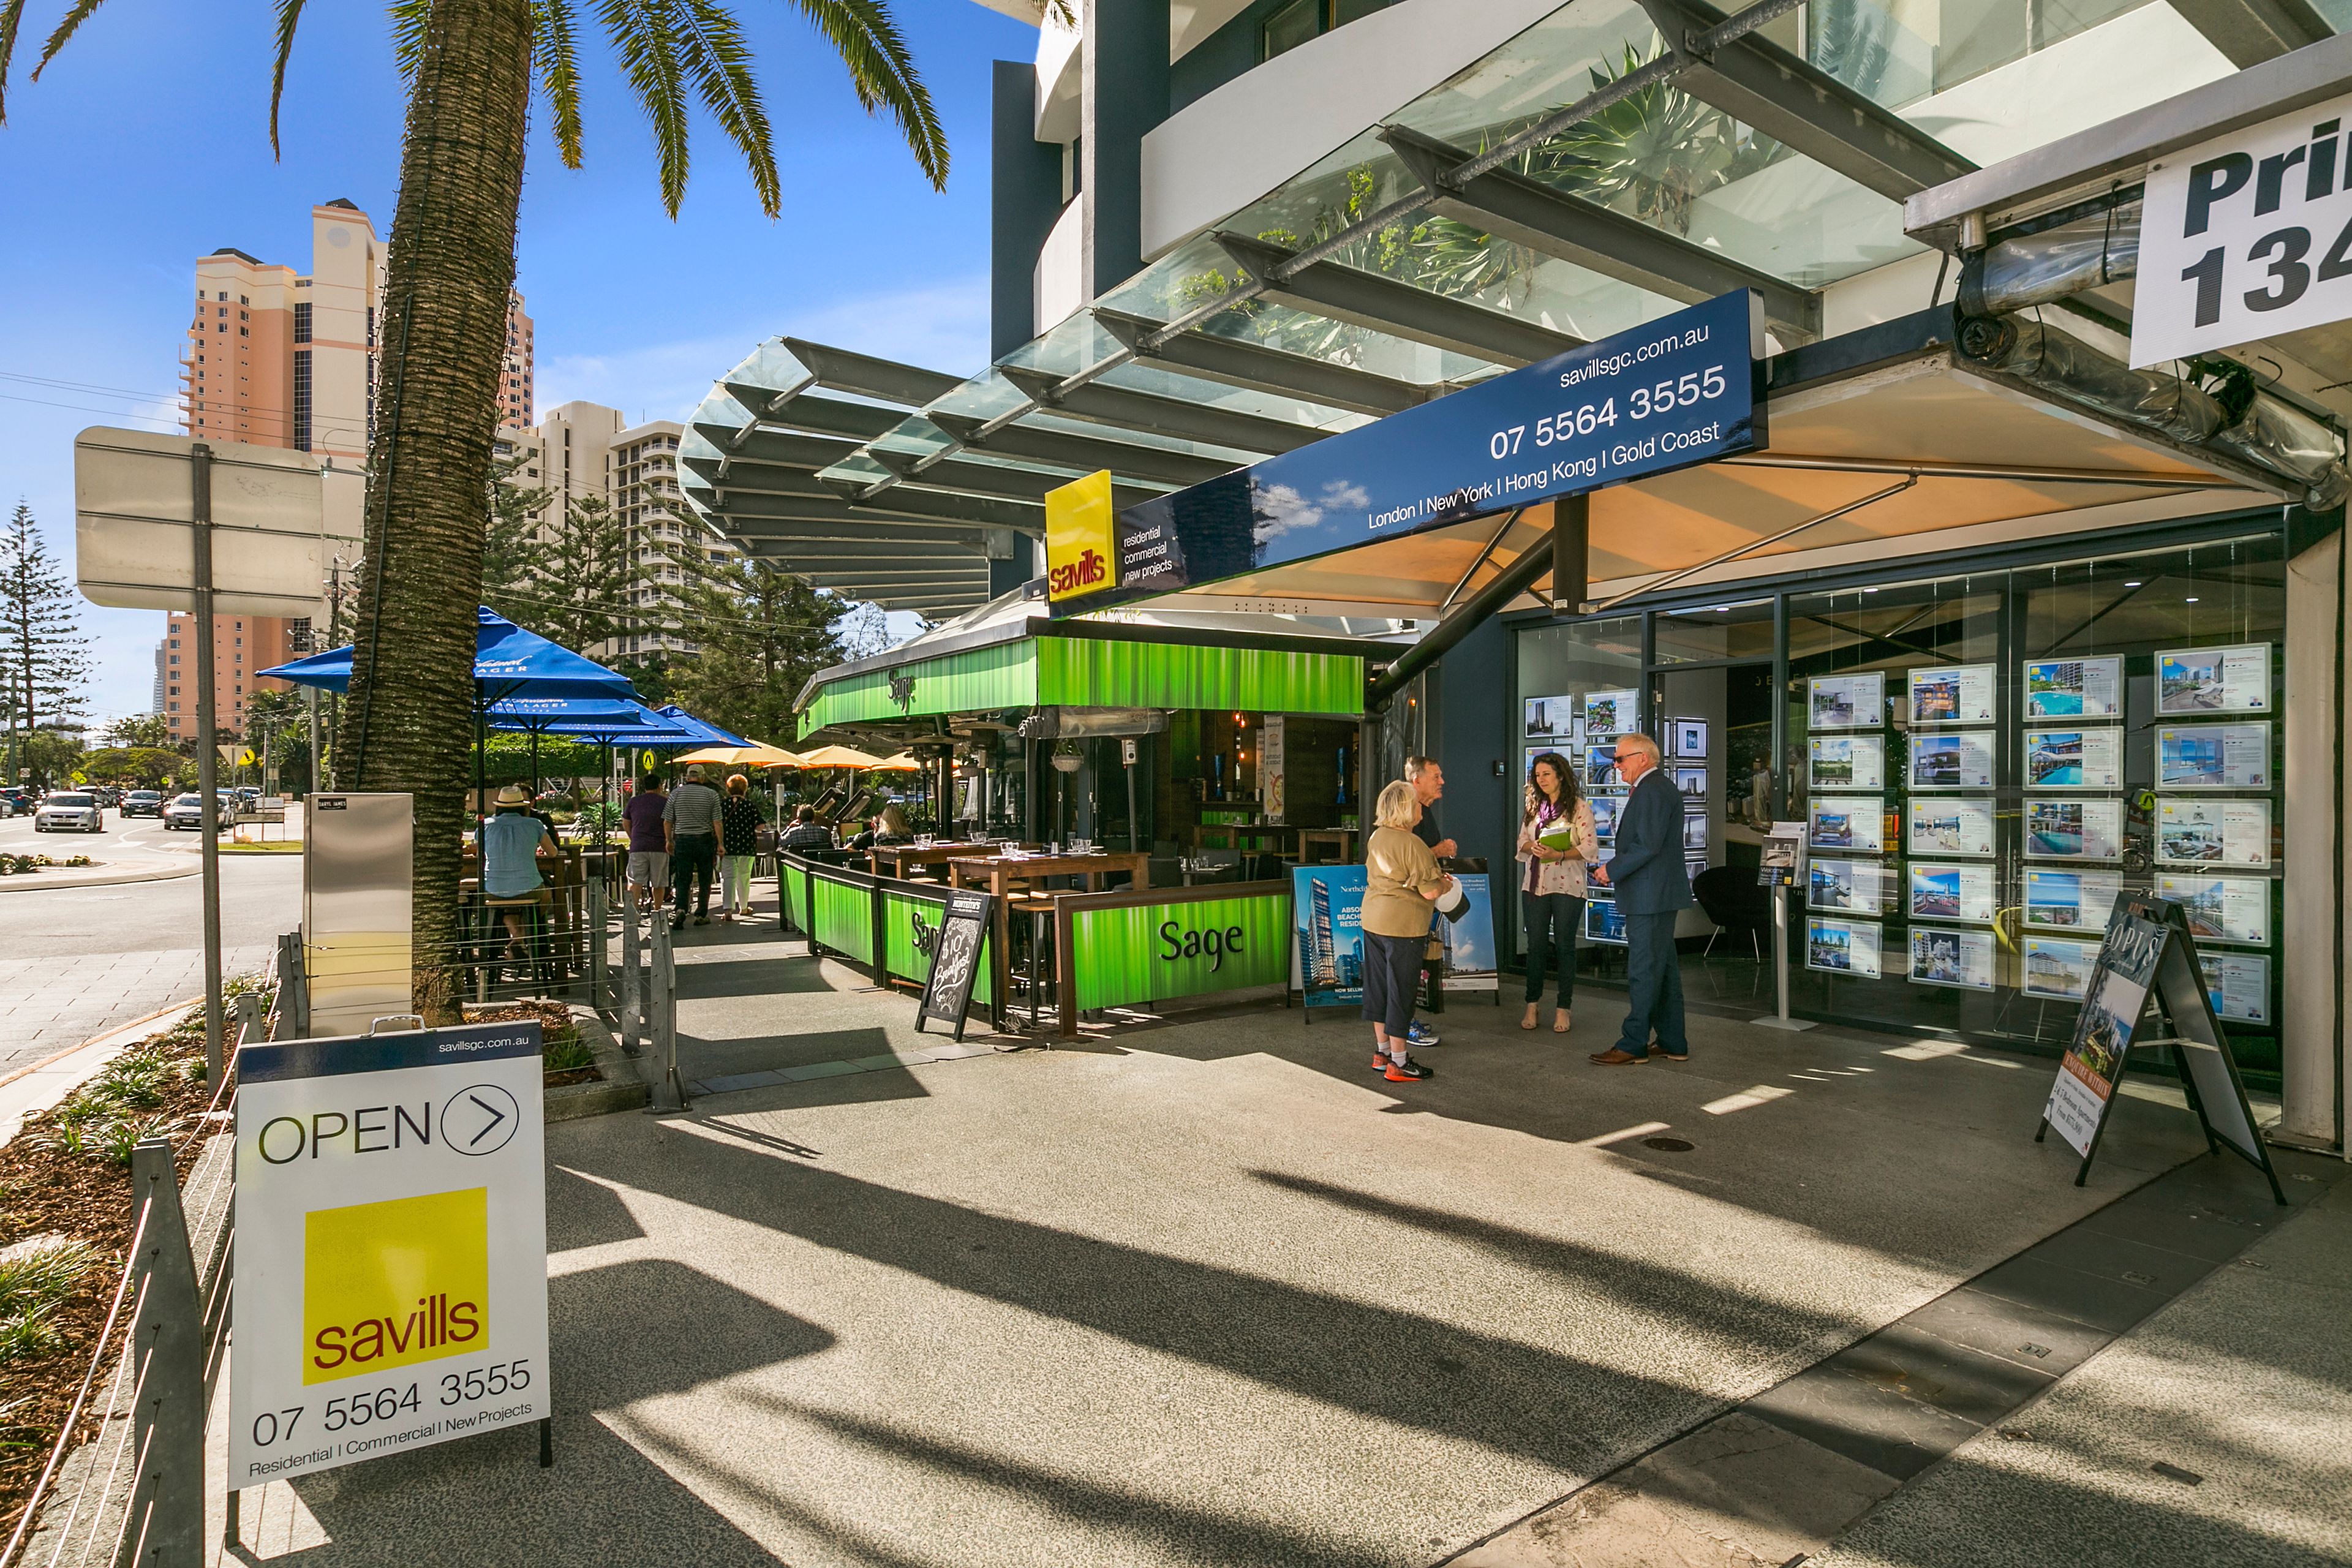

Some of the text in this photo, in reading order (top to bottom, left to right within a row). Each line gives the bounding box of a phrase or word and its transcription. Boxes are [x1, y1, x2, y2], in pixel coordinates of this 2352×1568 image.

[2184, 117, 2352, 239] Pri
[1560, 325, 1709, 388] savillsgc.com.au
[1490, 364, 1726, 461] 07 5564 3555
[1368, 503, 1415, 529] London
[1427, 490, 1458, 512] New
[1460, 482, 1493, 504] York
[1505, 470, 1548, 493] Hong
[1552, 454, 1597, 481] Kong
[1611, 438, 1655, 466] Gold
[1660, 420, 1719, 453] Coast
[1123, 525, 1161, 548] residential
[1124, 541, 1167, 565] commercial
[1050, 549, 1106, 594] savills
[1125, 559, 1172, 582] new projects
[888, 669, 911, 711] Sage
[941, 935, 962, 961] $10
[1159, 921, 1243, 973] Sage
[2110, 923, 2159, 967] OPUS
[439, 1036, 529, 1053] savillsgc.com.au
[258, 1101, 430, 1164] OPEN
[314, 1292, 480, 1370] savills
[253, 1359, 531, 1447] 07 5564 3555
[249, 1446, 333, 1477] Residential
[346, 1423, 436, 1455] Commercial
[446, 1415, 477, 1433] New
[478, 1402, 533, 1427] Projects
